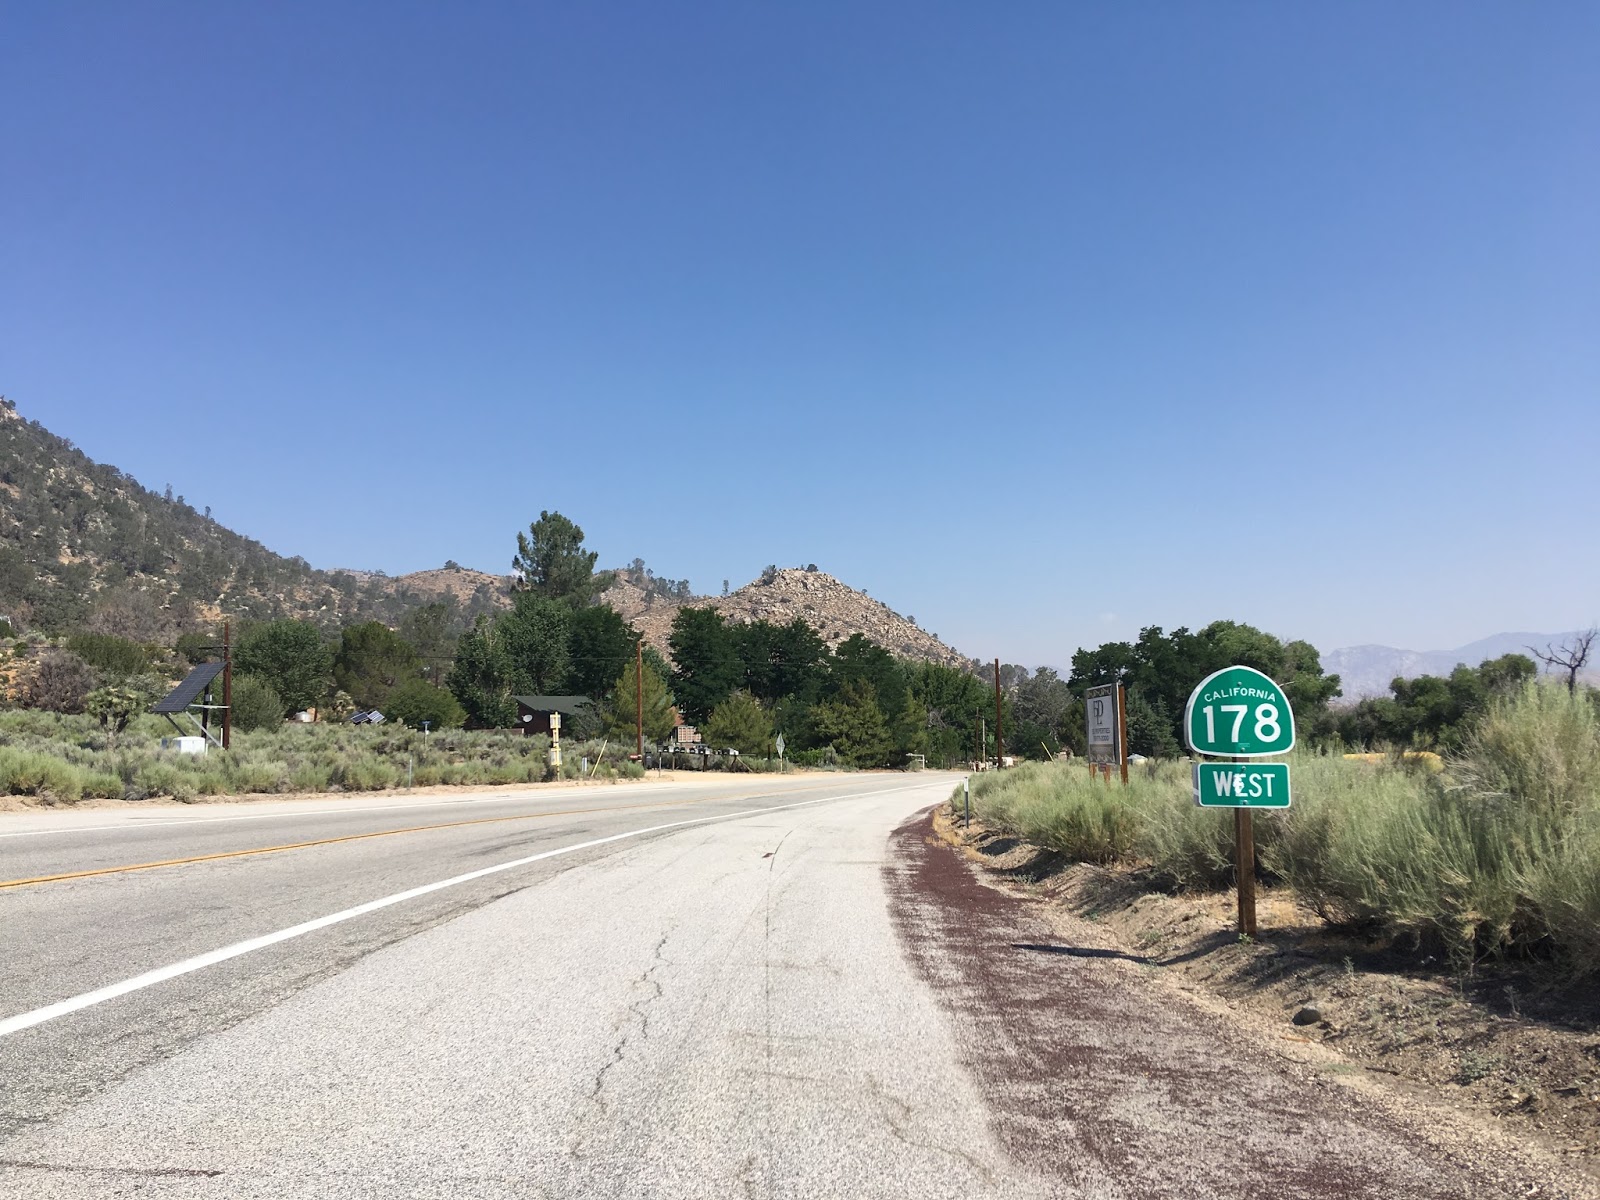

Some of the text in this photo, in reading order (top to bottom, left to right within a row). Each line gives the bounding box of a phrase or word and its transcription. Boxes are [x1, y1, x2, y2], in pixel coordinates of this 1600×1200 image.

[1204, 687, 1276, 702] CALIFORNIA
[1203, 703, 1281, 743] 178
[1213, 771, 1275, 797] WEST
